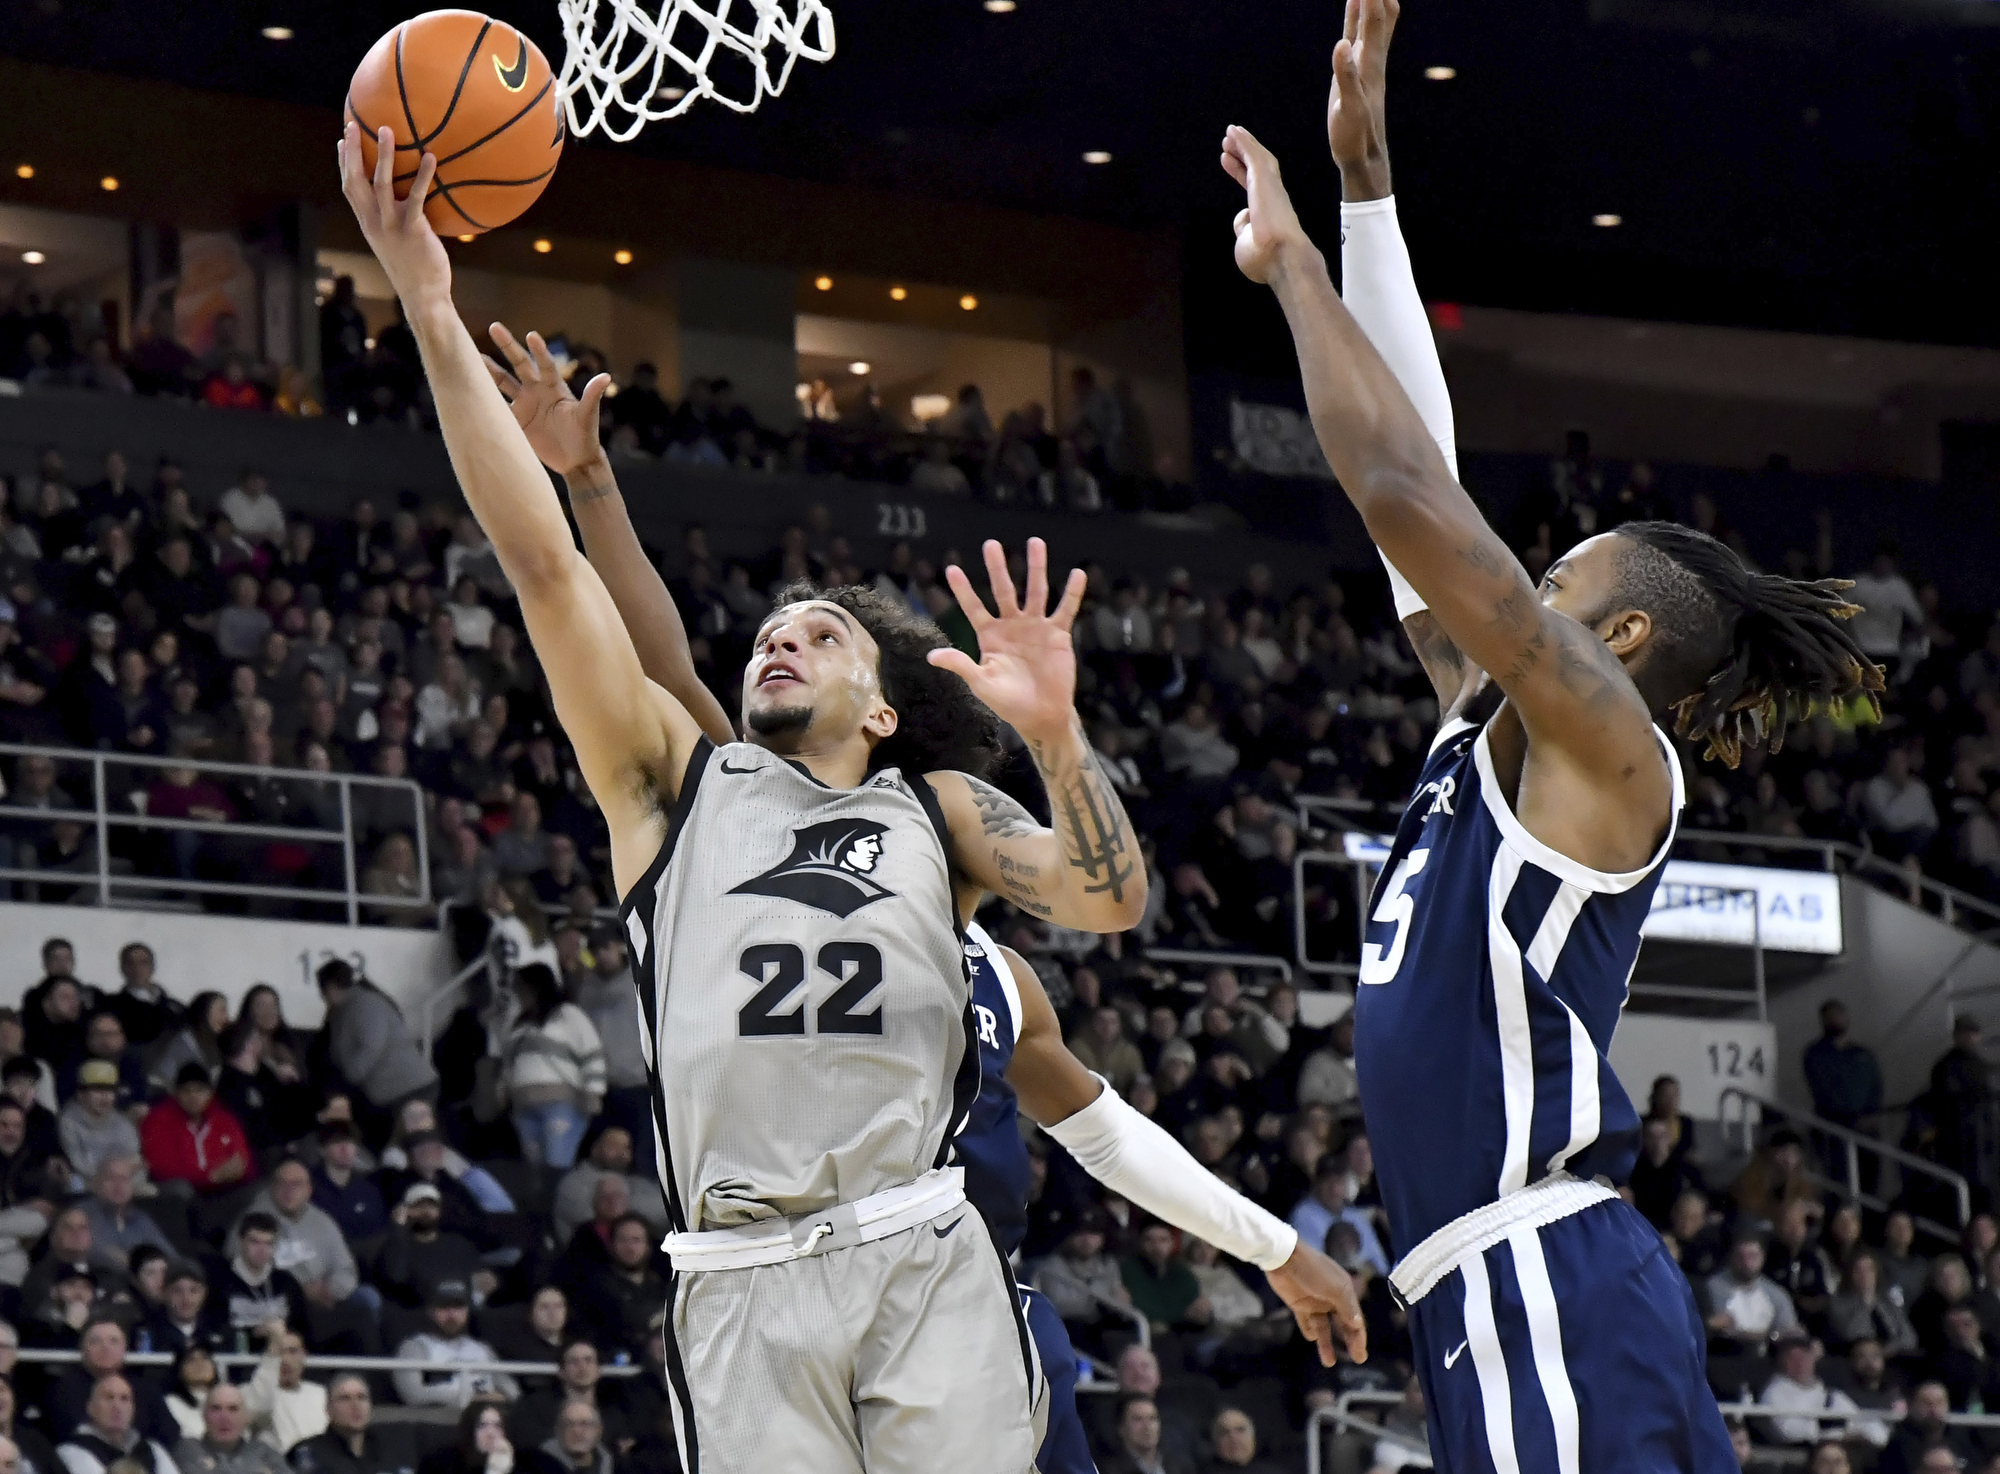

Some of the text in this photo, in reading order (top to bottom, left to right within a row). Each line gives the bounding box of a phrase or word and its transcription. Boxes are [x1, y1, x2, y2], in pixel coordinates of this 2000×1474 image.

[879, 503, 927, 537] 233
[737, 940, 885, 1037] 22
[1706, 1042, 1765, 1077] 124
